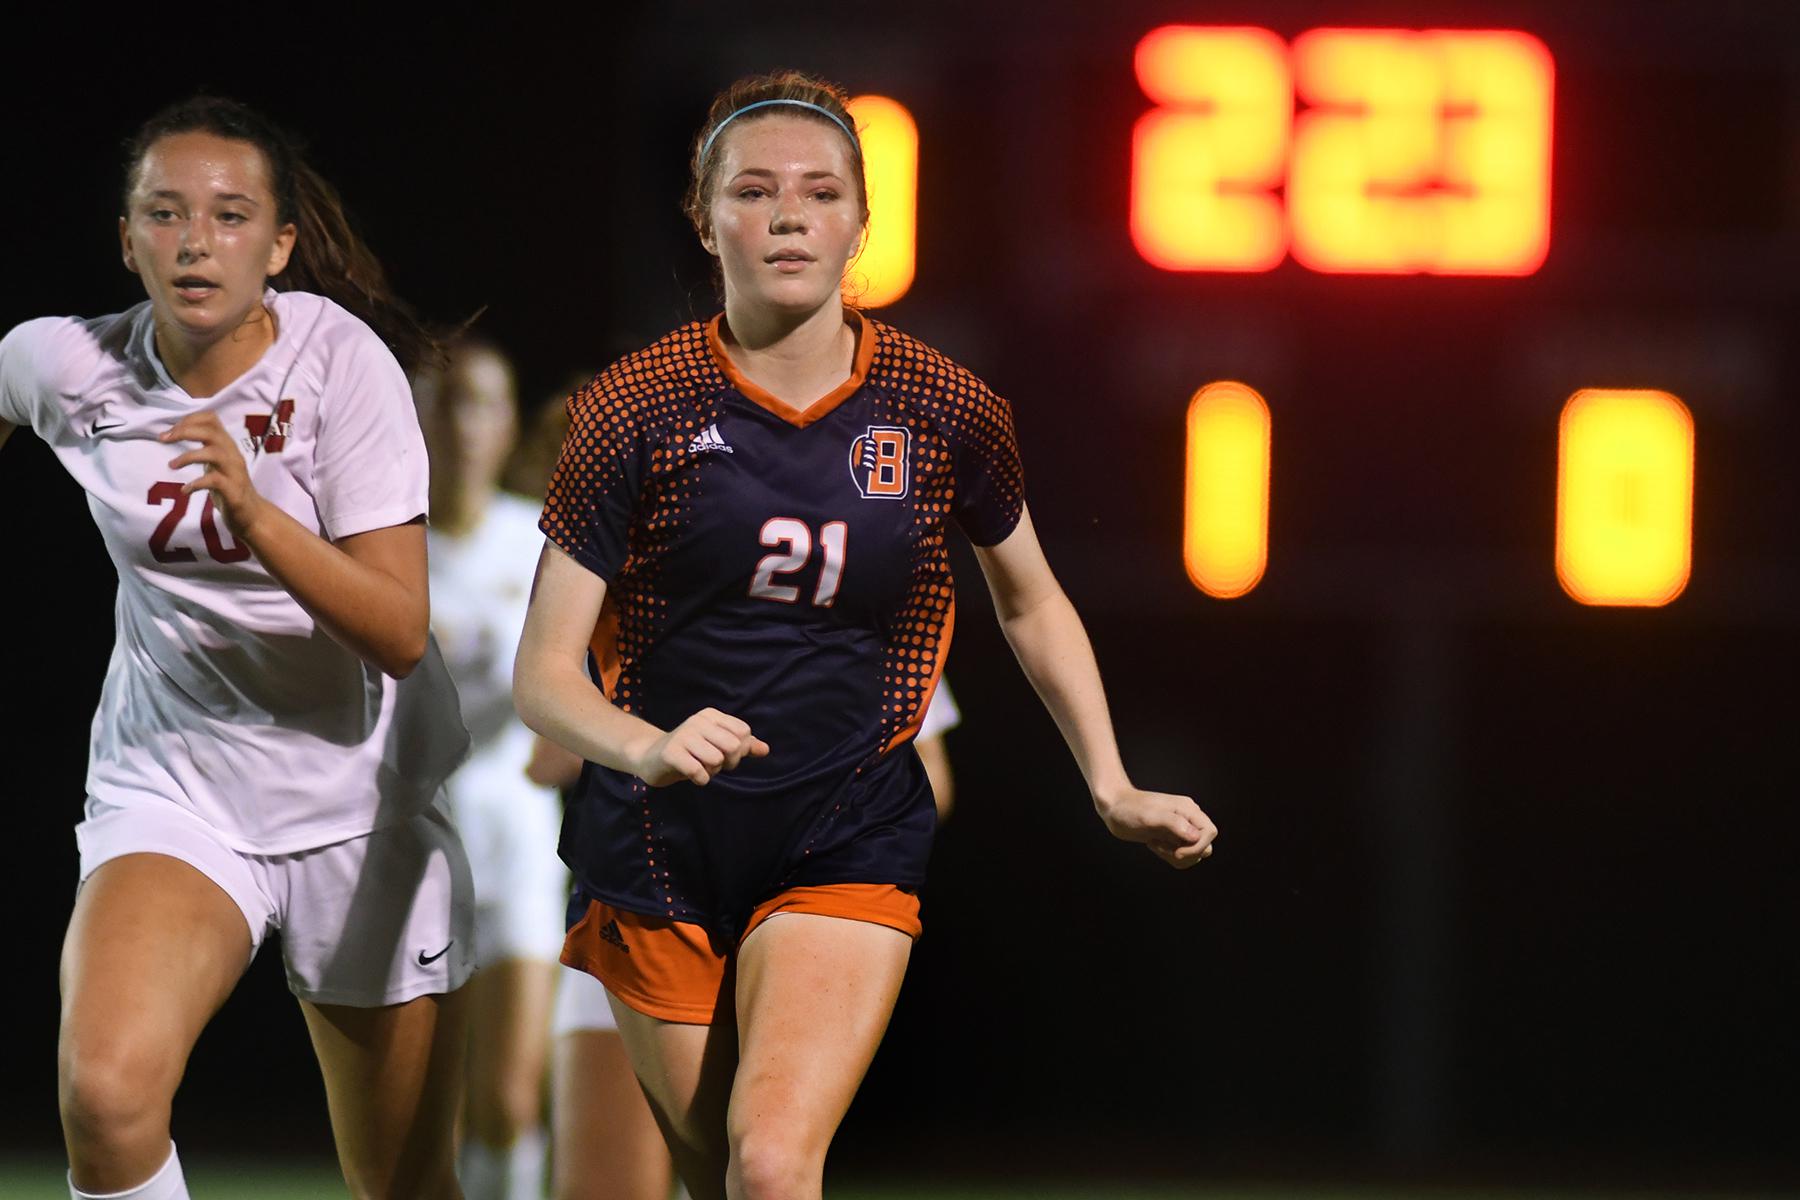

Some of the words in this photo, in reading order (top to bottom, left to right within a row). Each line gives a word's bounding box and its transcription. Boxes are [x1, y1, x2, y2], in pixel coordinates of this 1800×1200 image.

[688, 440, 734, 454] adidas
[859, 426, 909, 499] B
[147, 481, 251, 564] 20
[749, 516, 848, 608] 21
